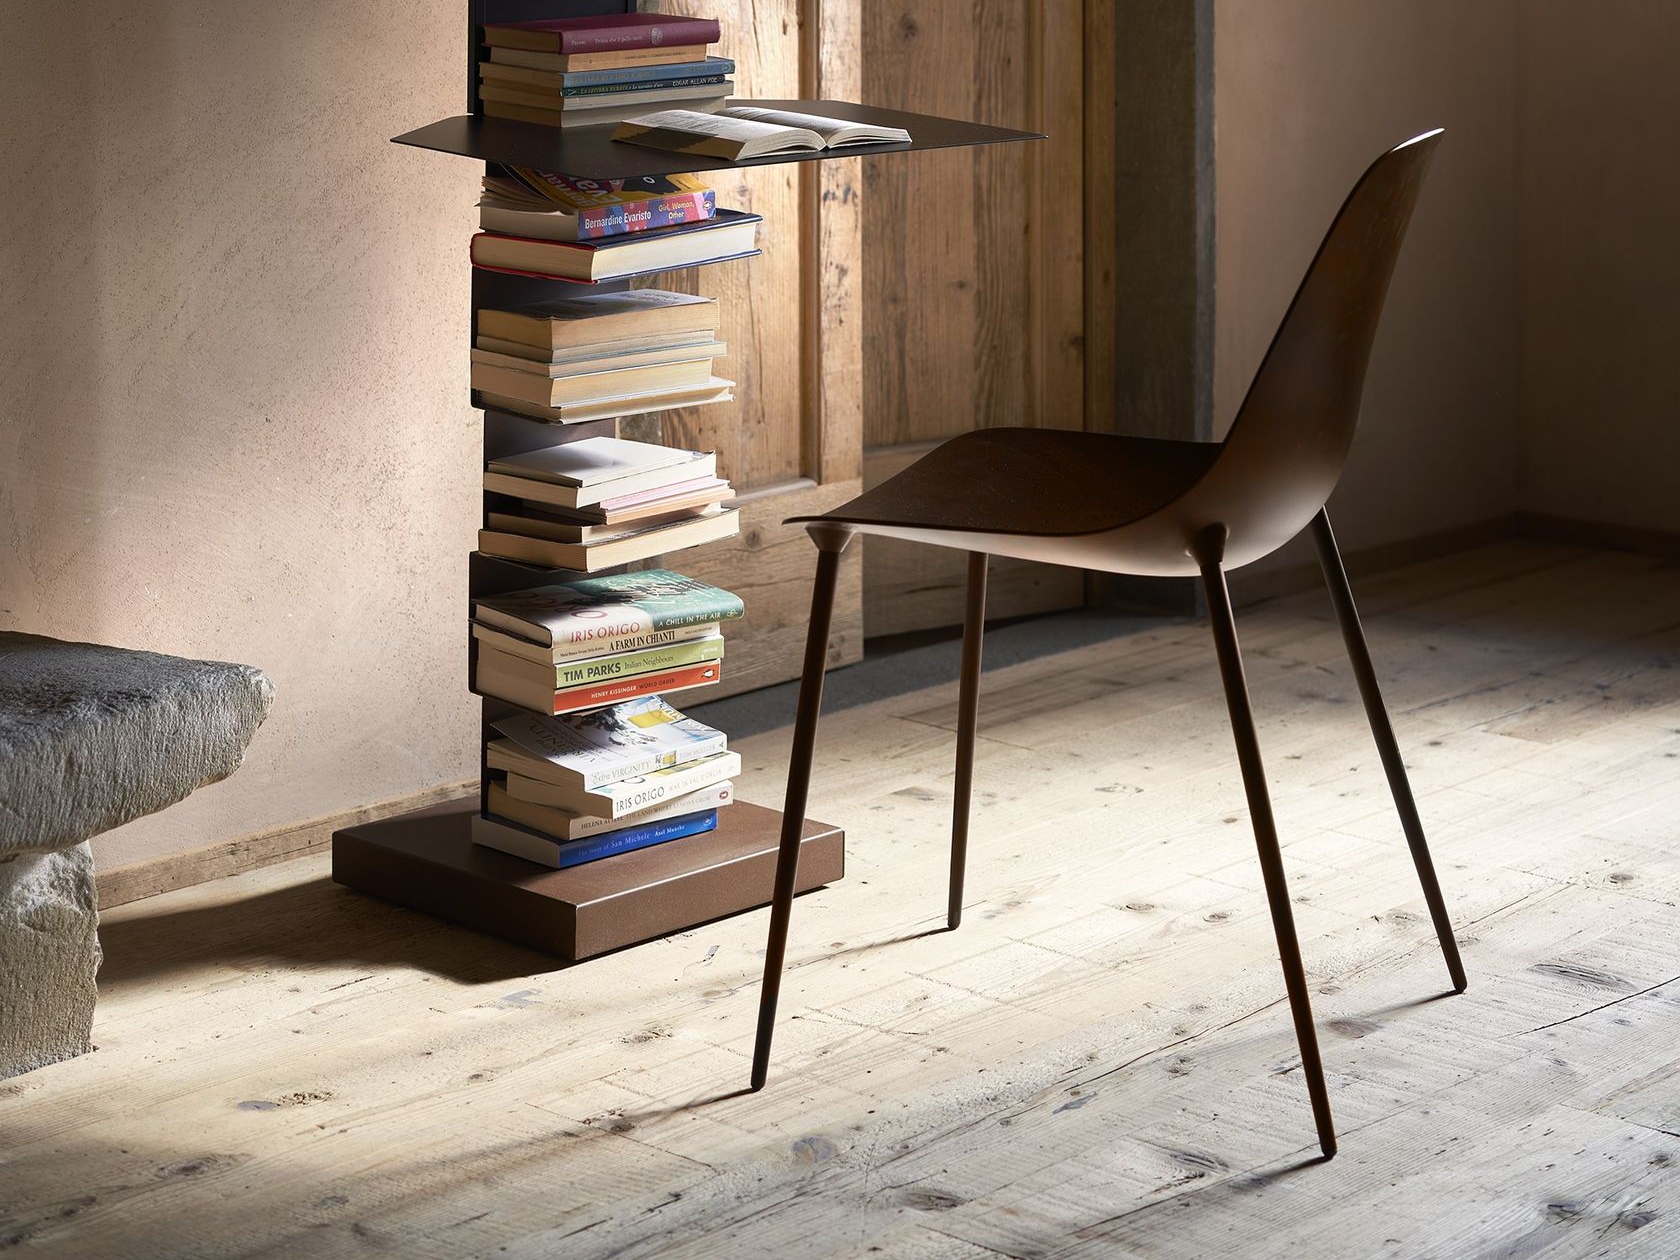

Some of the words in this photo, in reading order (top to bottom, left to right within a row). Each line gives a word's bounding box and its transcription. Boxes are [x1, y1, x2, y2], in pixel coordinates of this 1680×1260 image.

[659, 204, 669, 212] Girl,
[671, 202, 695, 211] Woman,
[668, 211, 684, 219] Other
[585, 215, 623, 229] Bernardine
[624, 211, 652, 223] Evaristo
[569, 629, 593, 643] IRIS
[597, 622, 640, 639] ORIGO
[609, 641, 614, 651] A
[616, 637, 636, 650] FARM
[637, 636, 645, 646] IN
[646, 631, 675, 645] CHIANTI
[564, 669, 583, 682] TIM
[588, 662, 621, 678] PARKS
[624, 661, 641, 669] Italian
[643, 655, 674, 667] Neighbours
[610, 686, 637, 695] KISSINGER
[612, 760, 651, 779] VIRGINITY
[616, 797, 632, 811] IRIS
[634, 787, 664, 805] ORIGO
[581, 820, 603, 829] HELENA
[637, 808, 653, 818] LAND
[611, 840, 622, 848] San
[625, 833, 650, 845] Michele
[667, 824, 685, 834] Munthe
